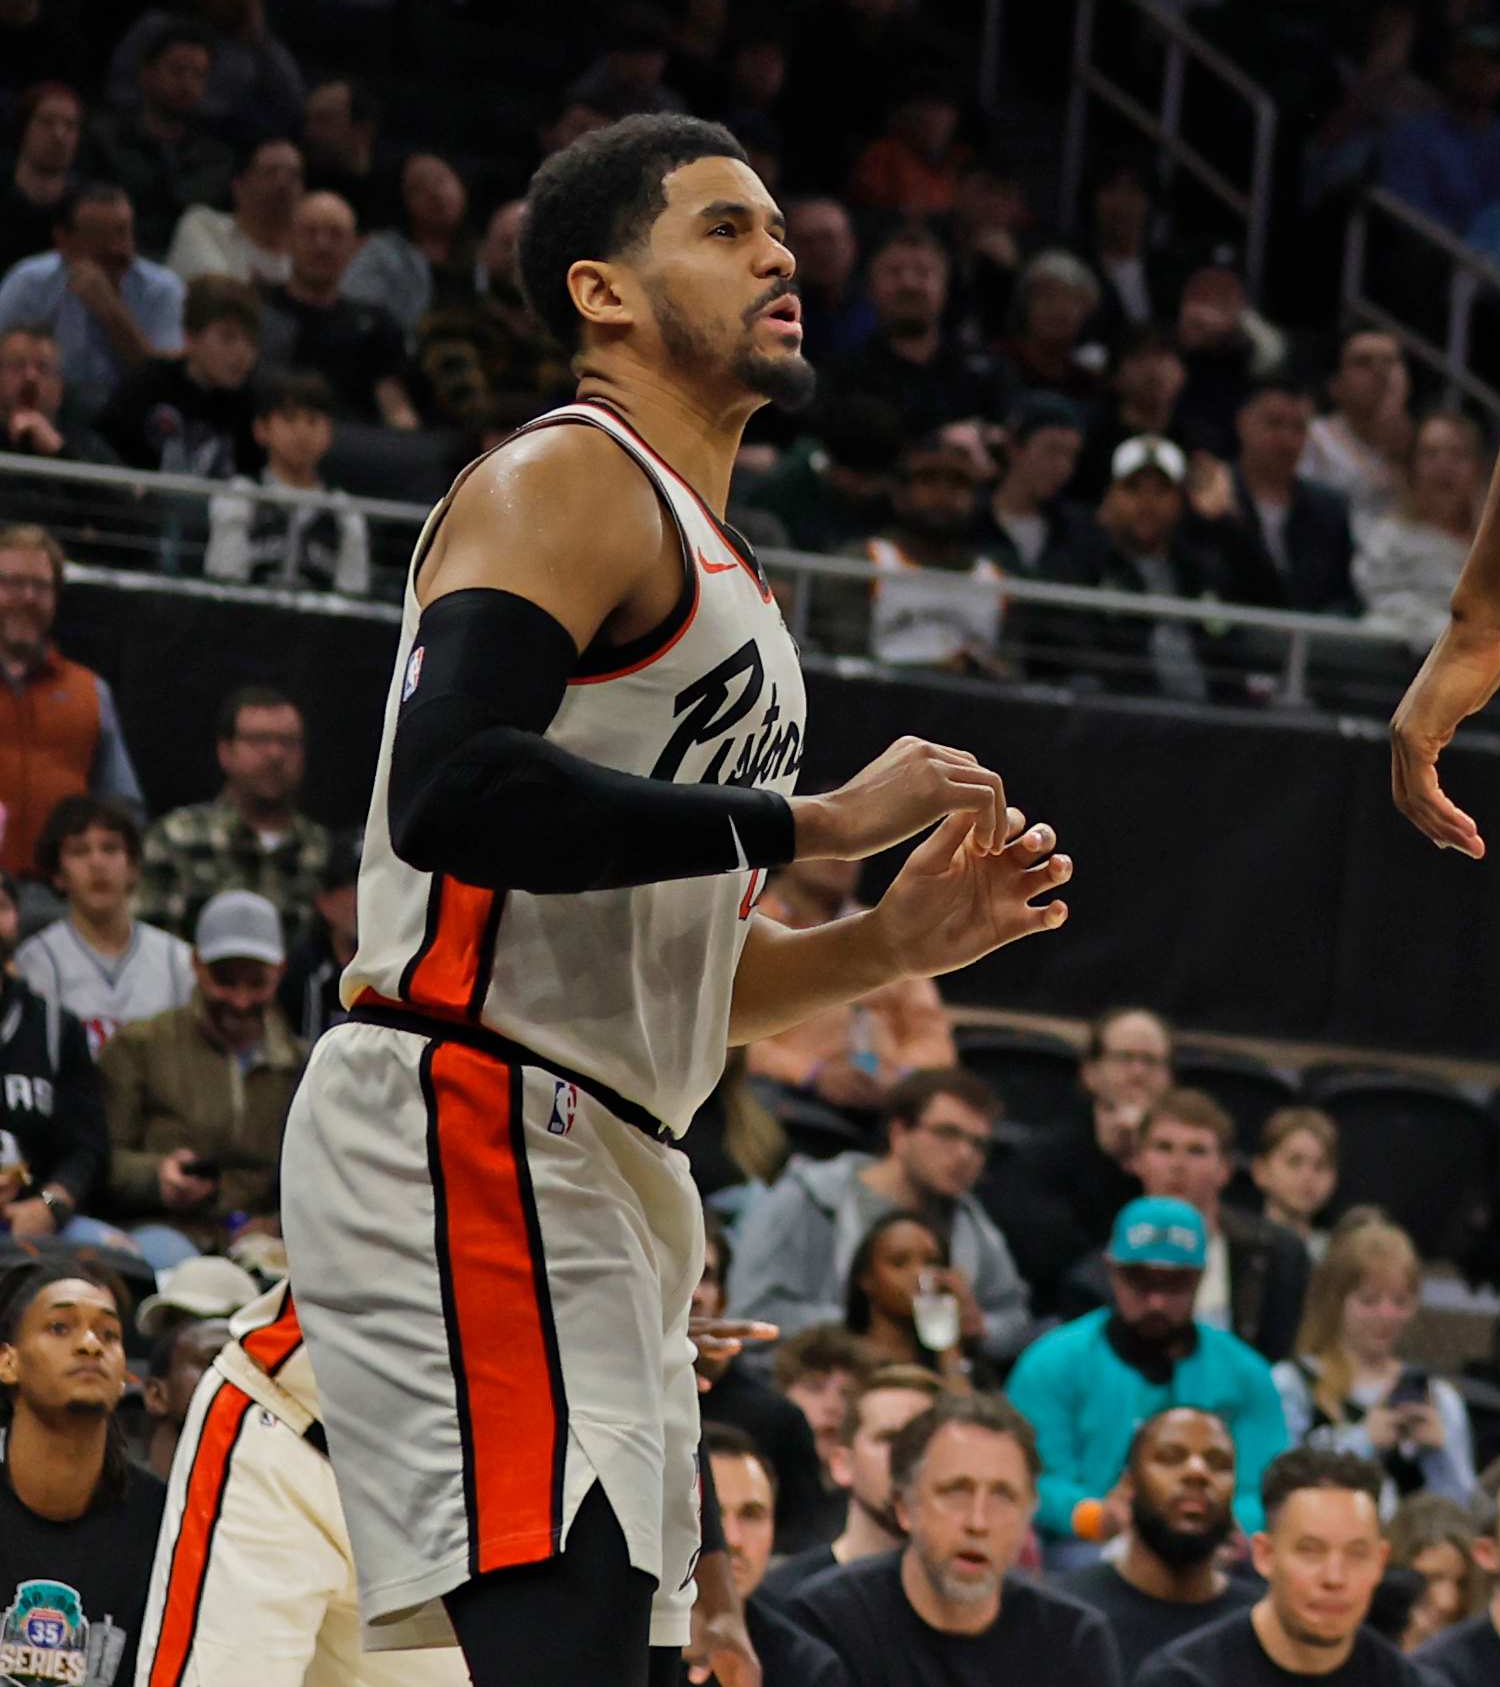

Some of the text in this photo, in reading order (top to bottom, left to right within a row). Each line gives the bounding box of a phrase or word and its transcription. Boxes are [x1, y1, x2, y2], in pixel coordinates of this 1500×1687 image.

[650, 637, 807, 787] Piston
[31, 1622, 59, 1644] 35
[0, 1642, 87, 1686] SERIES
